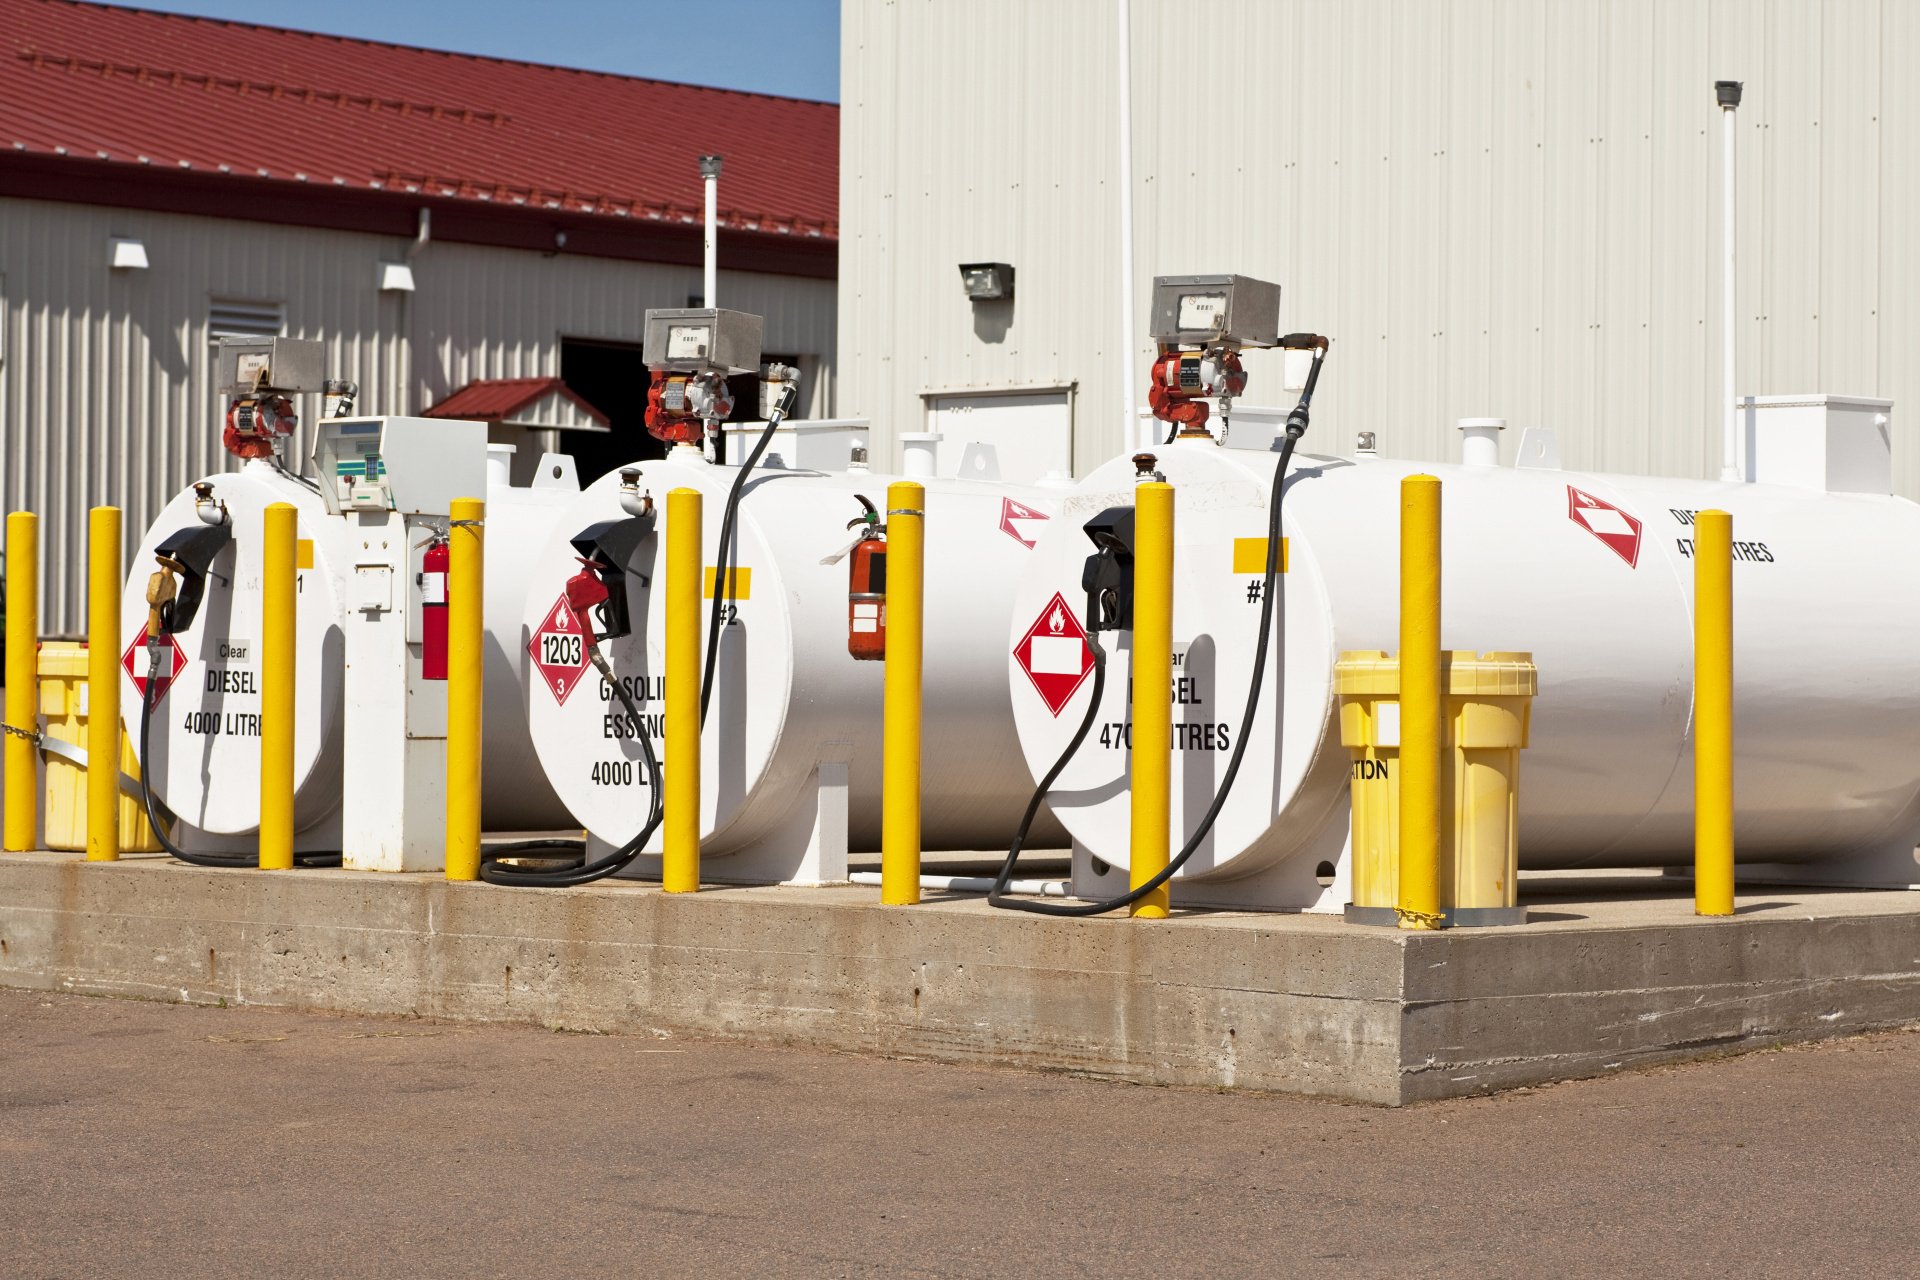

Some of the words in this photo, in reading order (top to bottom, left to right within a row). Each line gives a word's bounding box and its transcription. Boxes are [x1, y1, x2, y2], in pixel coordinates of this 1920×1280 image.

[219, 644, 247, 658] Clear
[543, 635, 582, 665] 1203
[207, 670, 257, 694] DIESEL
[556, 678, 565, 695] 3
[184, 712, 221, 735] 4000
[591, 761, 632, 786] 4000
